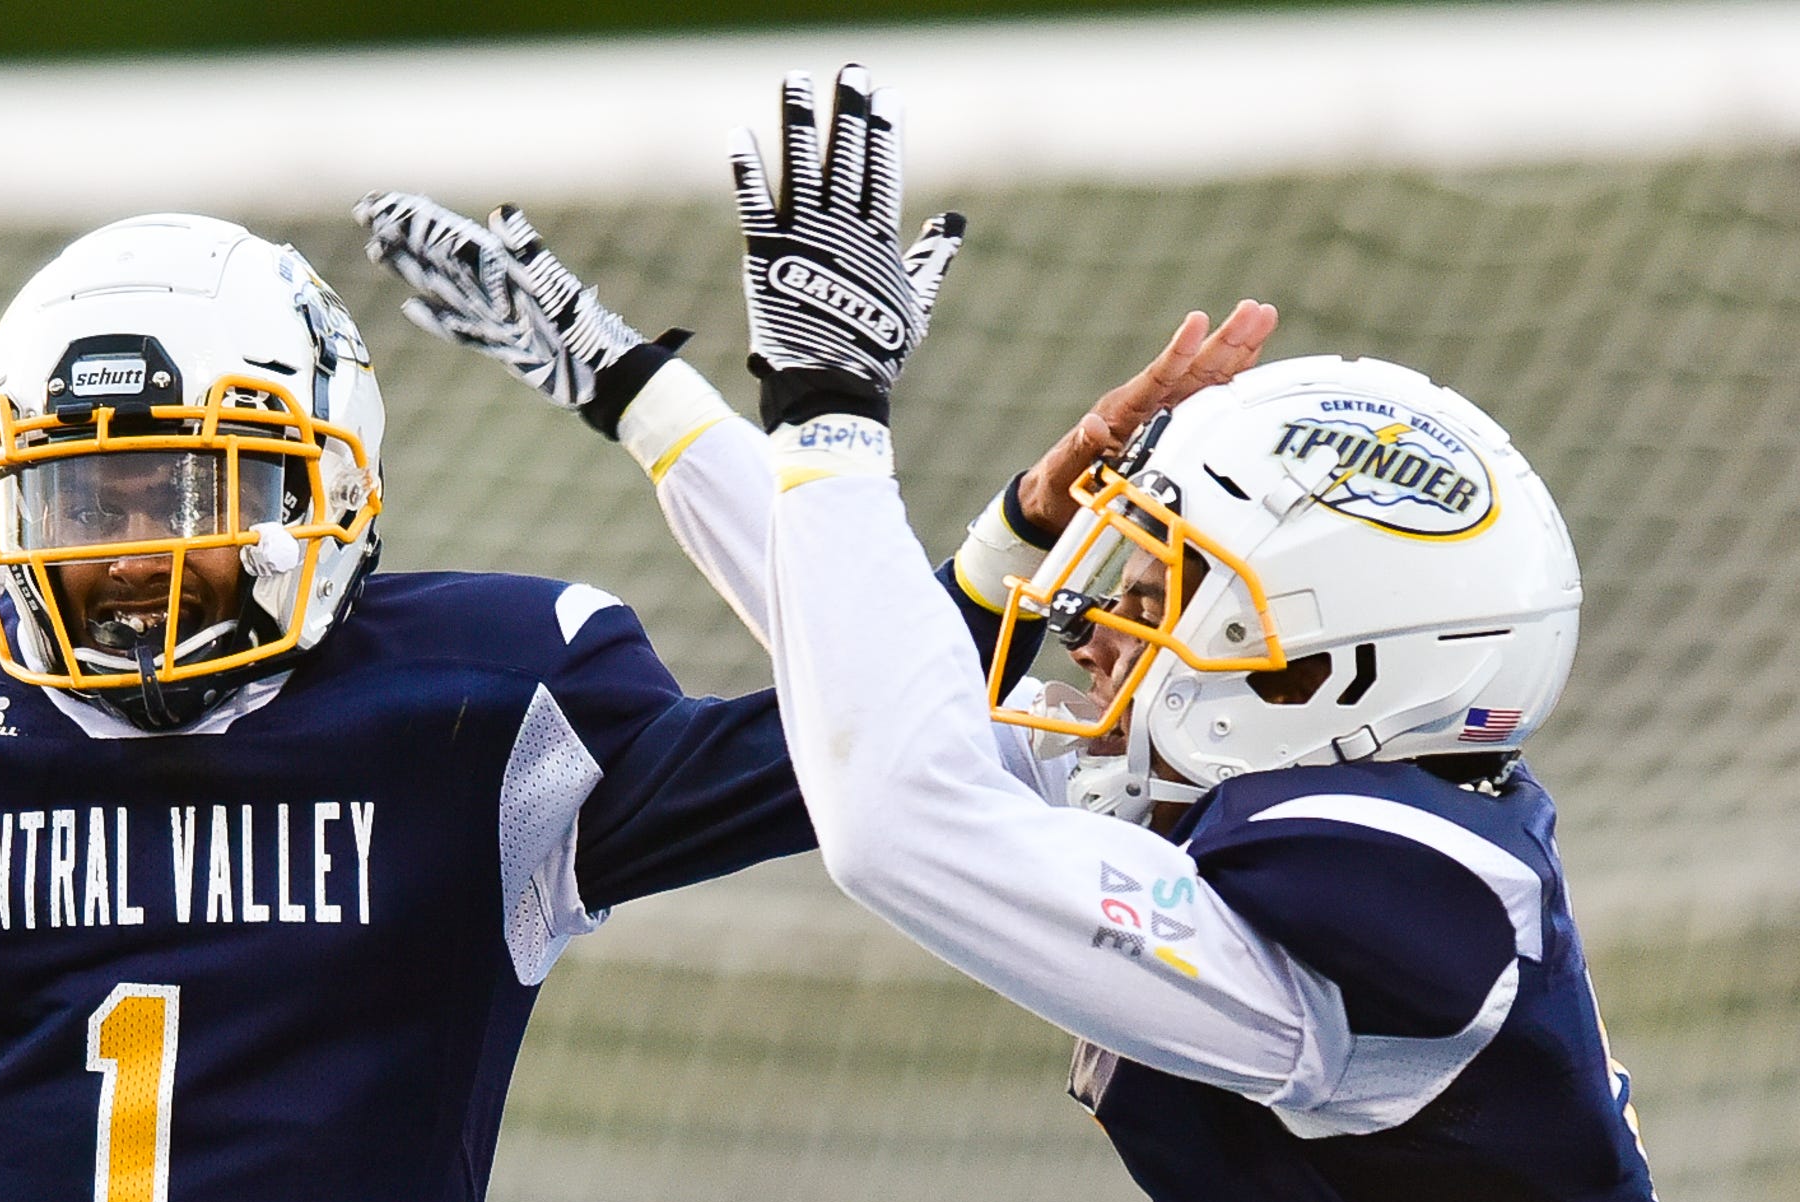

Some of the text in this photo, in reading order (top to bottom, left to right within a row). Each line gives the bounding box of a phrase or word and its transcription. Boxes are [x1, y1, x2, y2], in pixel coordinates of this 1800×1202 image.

[781, 263, 898, 341] BATTLE
[75, 367, 144, 387] schutt
[1320, 400, 1465, 454] CENTRAL VALLEY
[170, 801, 375, 925] VALLEY
